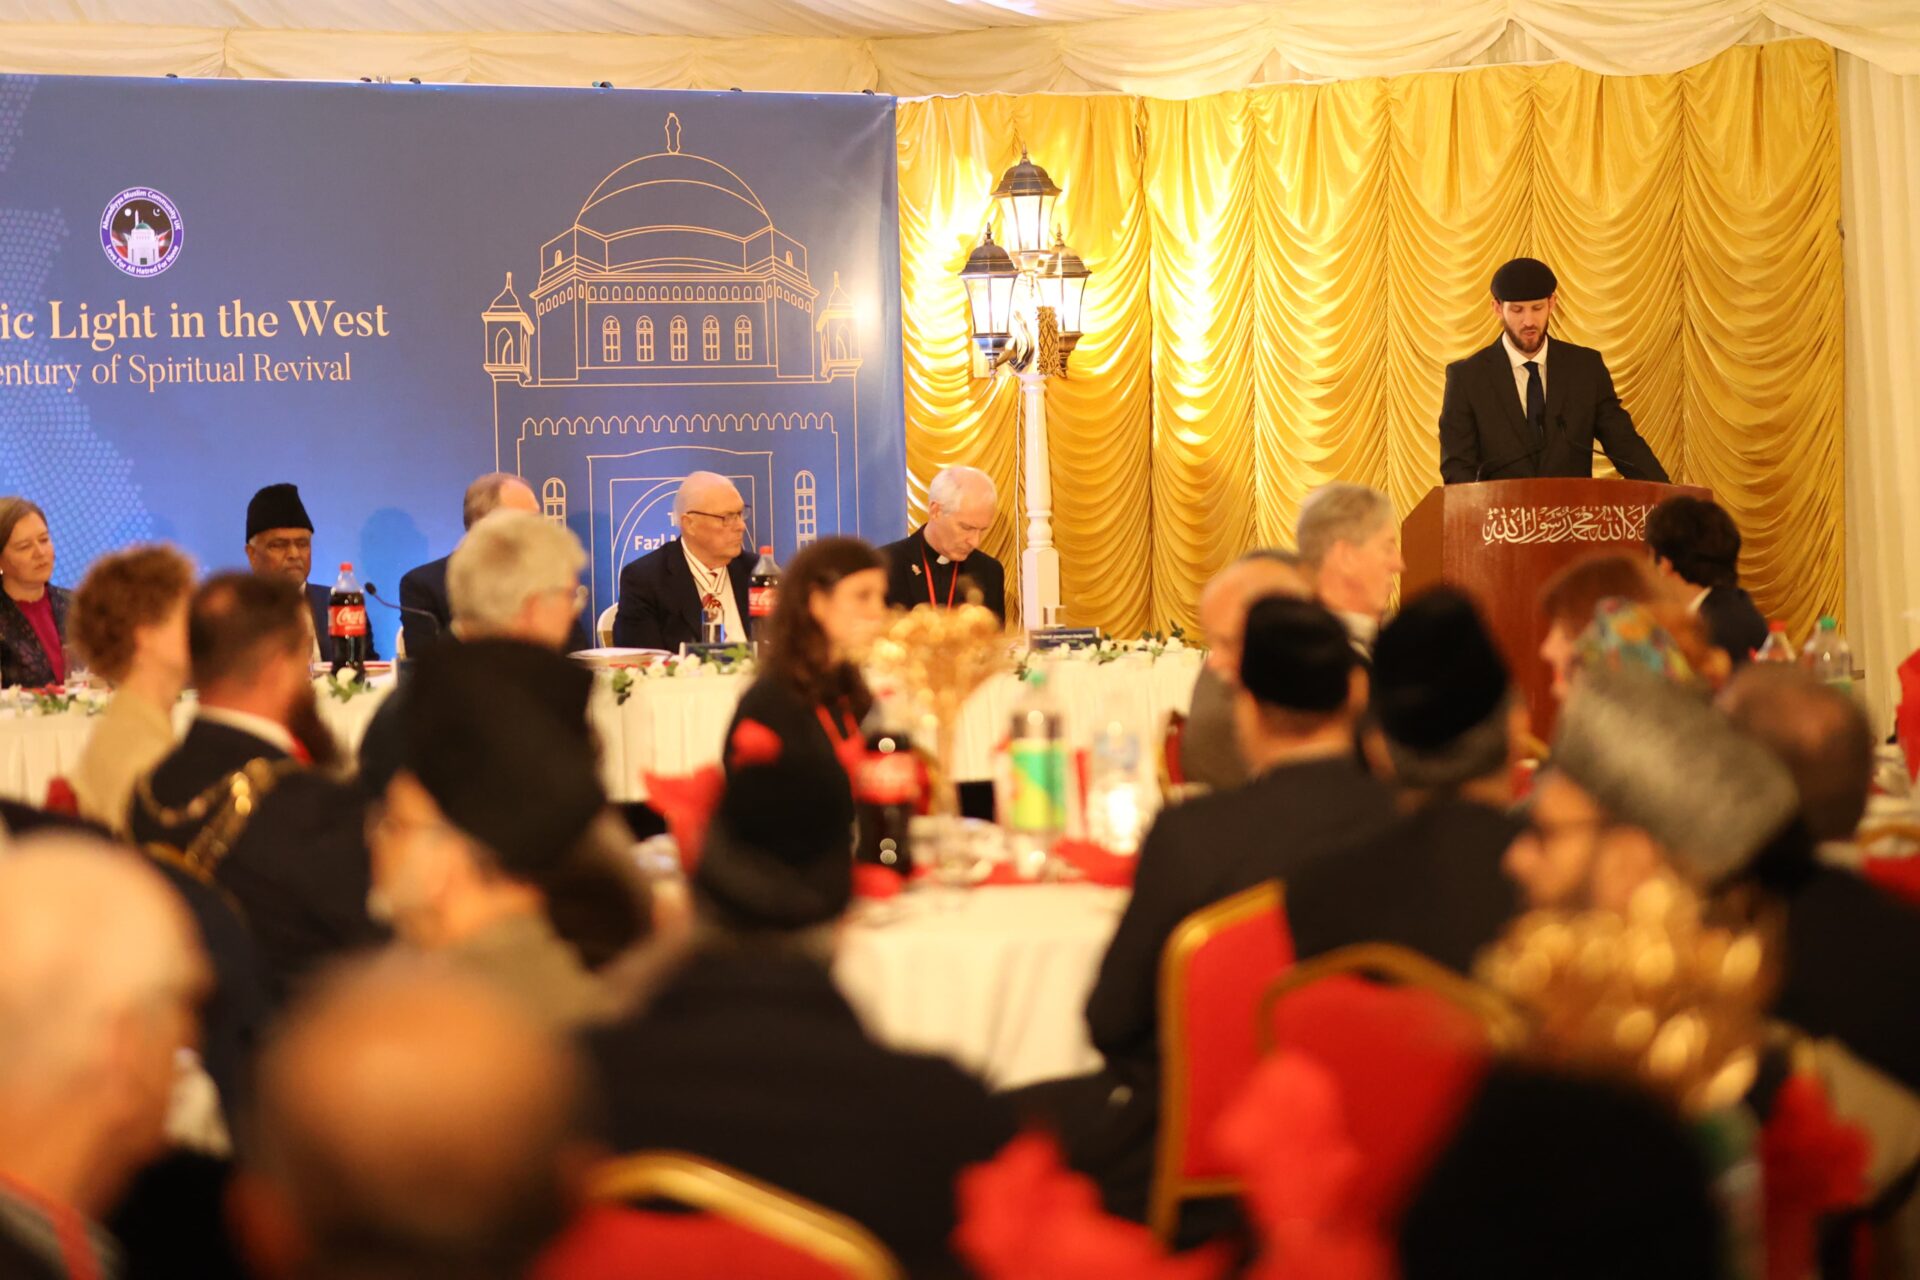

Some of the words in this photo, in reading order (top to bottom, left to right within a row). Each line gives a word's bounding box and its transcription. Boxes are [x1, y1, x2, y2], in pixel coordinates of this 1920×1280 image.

[103, 196, 124, 230] Ahmadiyya
[123, 190, 147, 198] Muslim
[147, 191, 177, 220] Community
[173, 219, 181, 231] UK
[105, 244, 117, 260] Love
[116, 258, 126, 269] For
[126, 265, 135, 273] All
[136, 267, 158, 275] Hatred
[157, 262, 167, 271] For
[166, 245, 179, 262] None
[48, 299, 158, 351] Light
[170, 302, 206, 338] in
[217, 299, 279, 338] the
[287, 299, 390, 337] West
[0, 359, 82, 393] ntury
[91, 353, 122, 384] of
[128, 352, 246, 393] Spiritual
[253, 352, 352, 382] Revival
[634, 533, 666, 551] Fazl
